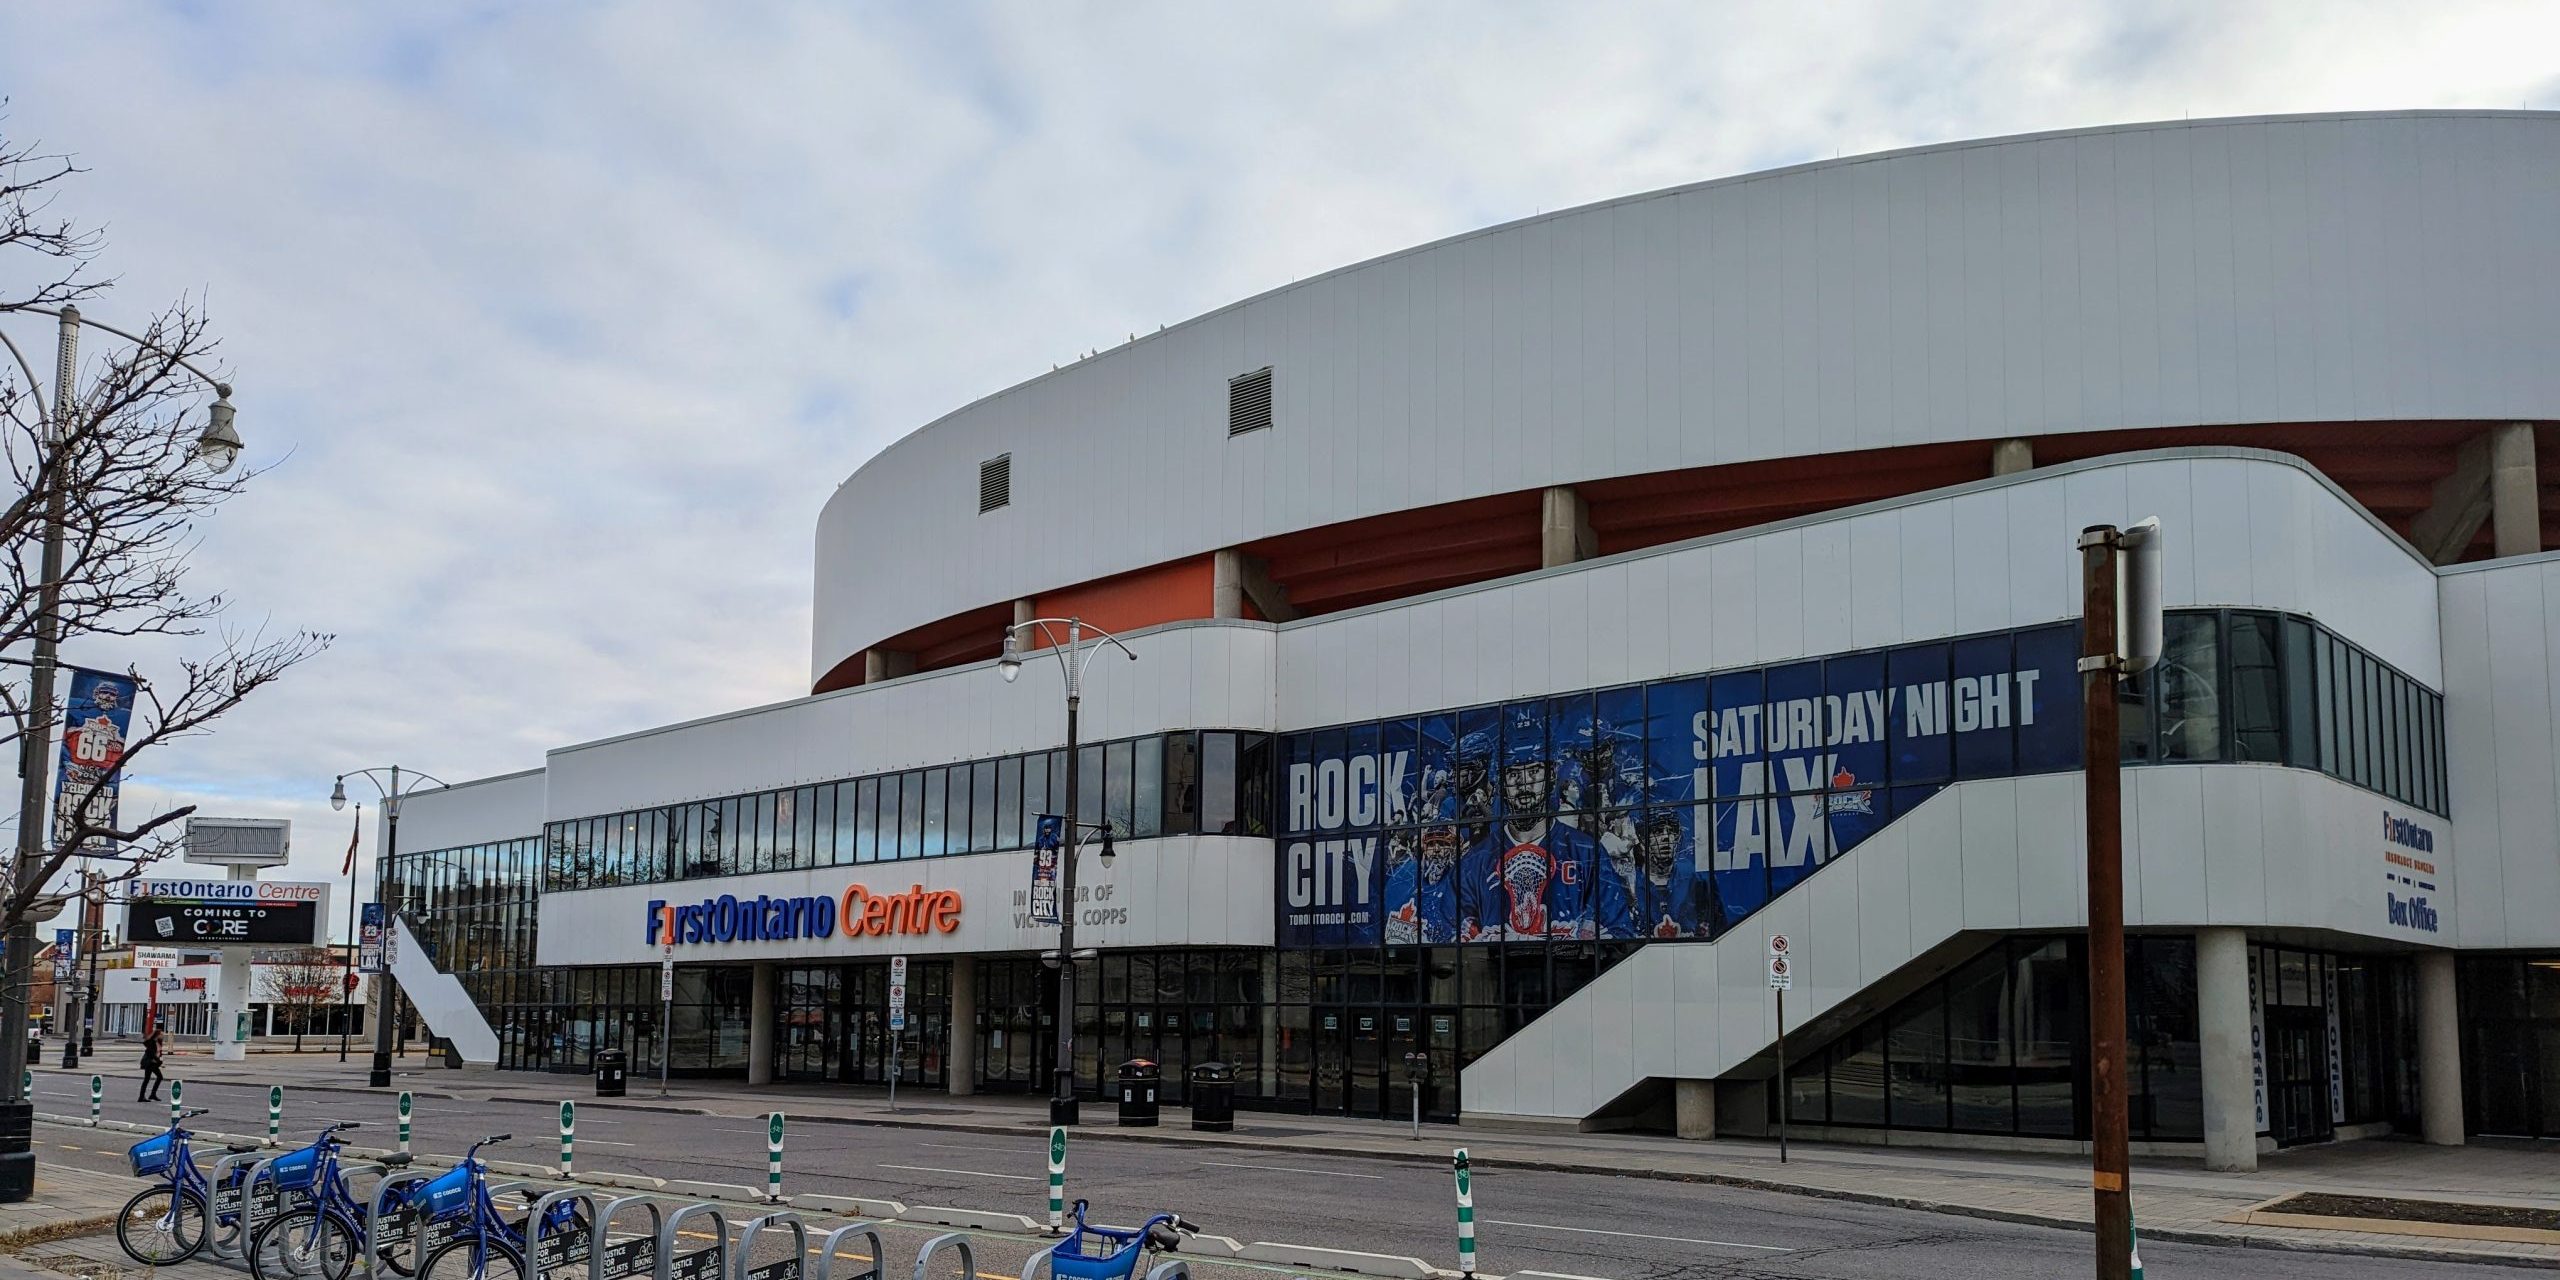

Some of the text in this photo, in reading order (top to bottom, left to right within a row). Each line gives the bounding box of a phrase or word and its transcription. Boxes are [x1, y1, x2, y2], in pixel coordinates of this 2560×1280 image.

[1693, 669, 2040, 760] SATURDAY NIGHT
[77, 733, 108, 762] 66
[62, 780, 104, 797] WELCOE
[103, 786, 114, 797] TO
[1289, 750, 1409, 832] ROCK
[1694, 754, 1839, 872] LAX
[1039, 849, 1052, 867] 93
[1288, 837, 1378, 908] CITY
[259, 883, 320, 899] Centre
[1013, 891, 1027, 906] IN
[1095, 884, 1113, 901] OF
[1033, 887, 1055, 900] ROCK
[184, 909, 267, 918] COMING TO
[840, 884, 962, 937] Centre
[1033, 900, 1055, 916] CITY
[2388, 892, 2438, 933] Box Office
[1083, 908, 1127, 925] COPPS
[193, 919, 248, 935] CORE
[365, 926, 377, 936] 23
[137, 951, 176, 960] SHAWARMA
[143, 959, 169, 968] ROYALE
[361, 956, 378, 969] LAX
[216, 1189, 241, 1199] JUSTICE
[250, 1194, 275, 1204] JUSTICE
[216, 1201, 242, 1211] CYCLISTS
[250, 1206, 278, 1217] CYCLISTS
[377, 1214, 401, 1224] JUSTICE
[376, 1228, 403, 1239] CYCLISTS
[377, 1223, 389, 1231] FOR
[427, 1222, 451, 1232] JUSTICE
[427, 1230, 440, 1238] FOR
[427, 1236, 454, 1247] CYCLISTS
[537, 1237, 560, 1250] JUSTICE
[537, 1249, 549, 1258] FOR
[569, 1245, 589, 1258] BIKING
[537, 1253, 564, 1267] CYCLISTS
[634, 1256, 653, 1268] BIKING
[603, 1262, 629, 1276] CYCLISTS
[701, 1266, 719, 1279] BIKING
